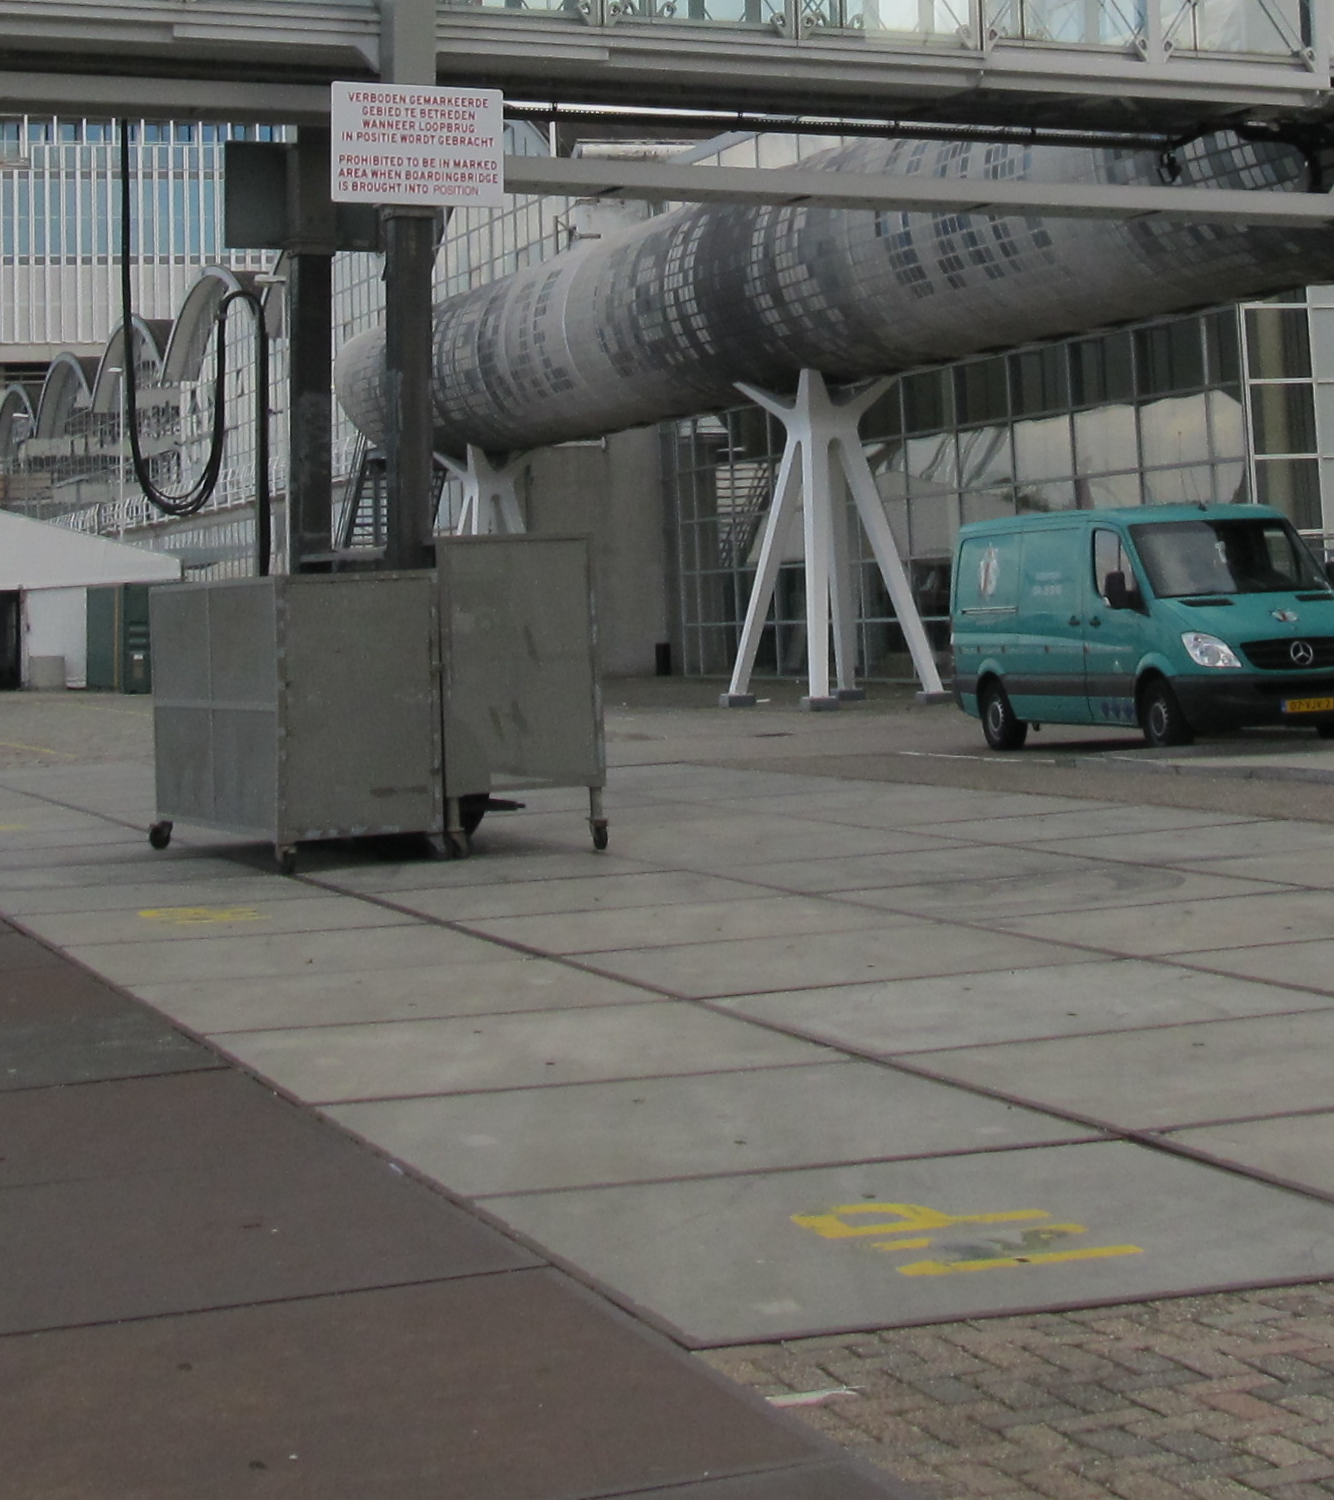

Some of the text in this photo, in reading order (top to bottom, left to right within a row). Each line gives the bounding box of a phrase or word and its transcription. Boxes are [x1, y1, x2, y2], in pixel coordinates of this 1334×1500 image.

[348, 92, 489, 109] VERBODEN GEMARKEERDE
[362, 106, 476, 121] GEBIED TE BETREDEN
[362, 119, 475, 133] WANNEER LOOPBRUG
[342, 131, 494, 147] IN POSITIE WORDT GEBRACHT
[339, 154, 498, 171] PROHIBITED TO BE IN MARKED
[338, 168, 499, 184] AREA WHEN BOARDINGBRIDGE
[338, 181, 479, 196] IS BROUGHT INTO POSITION
